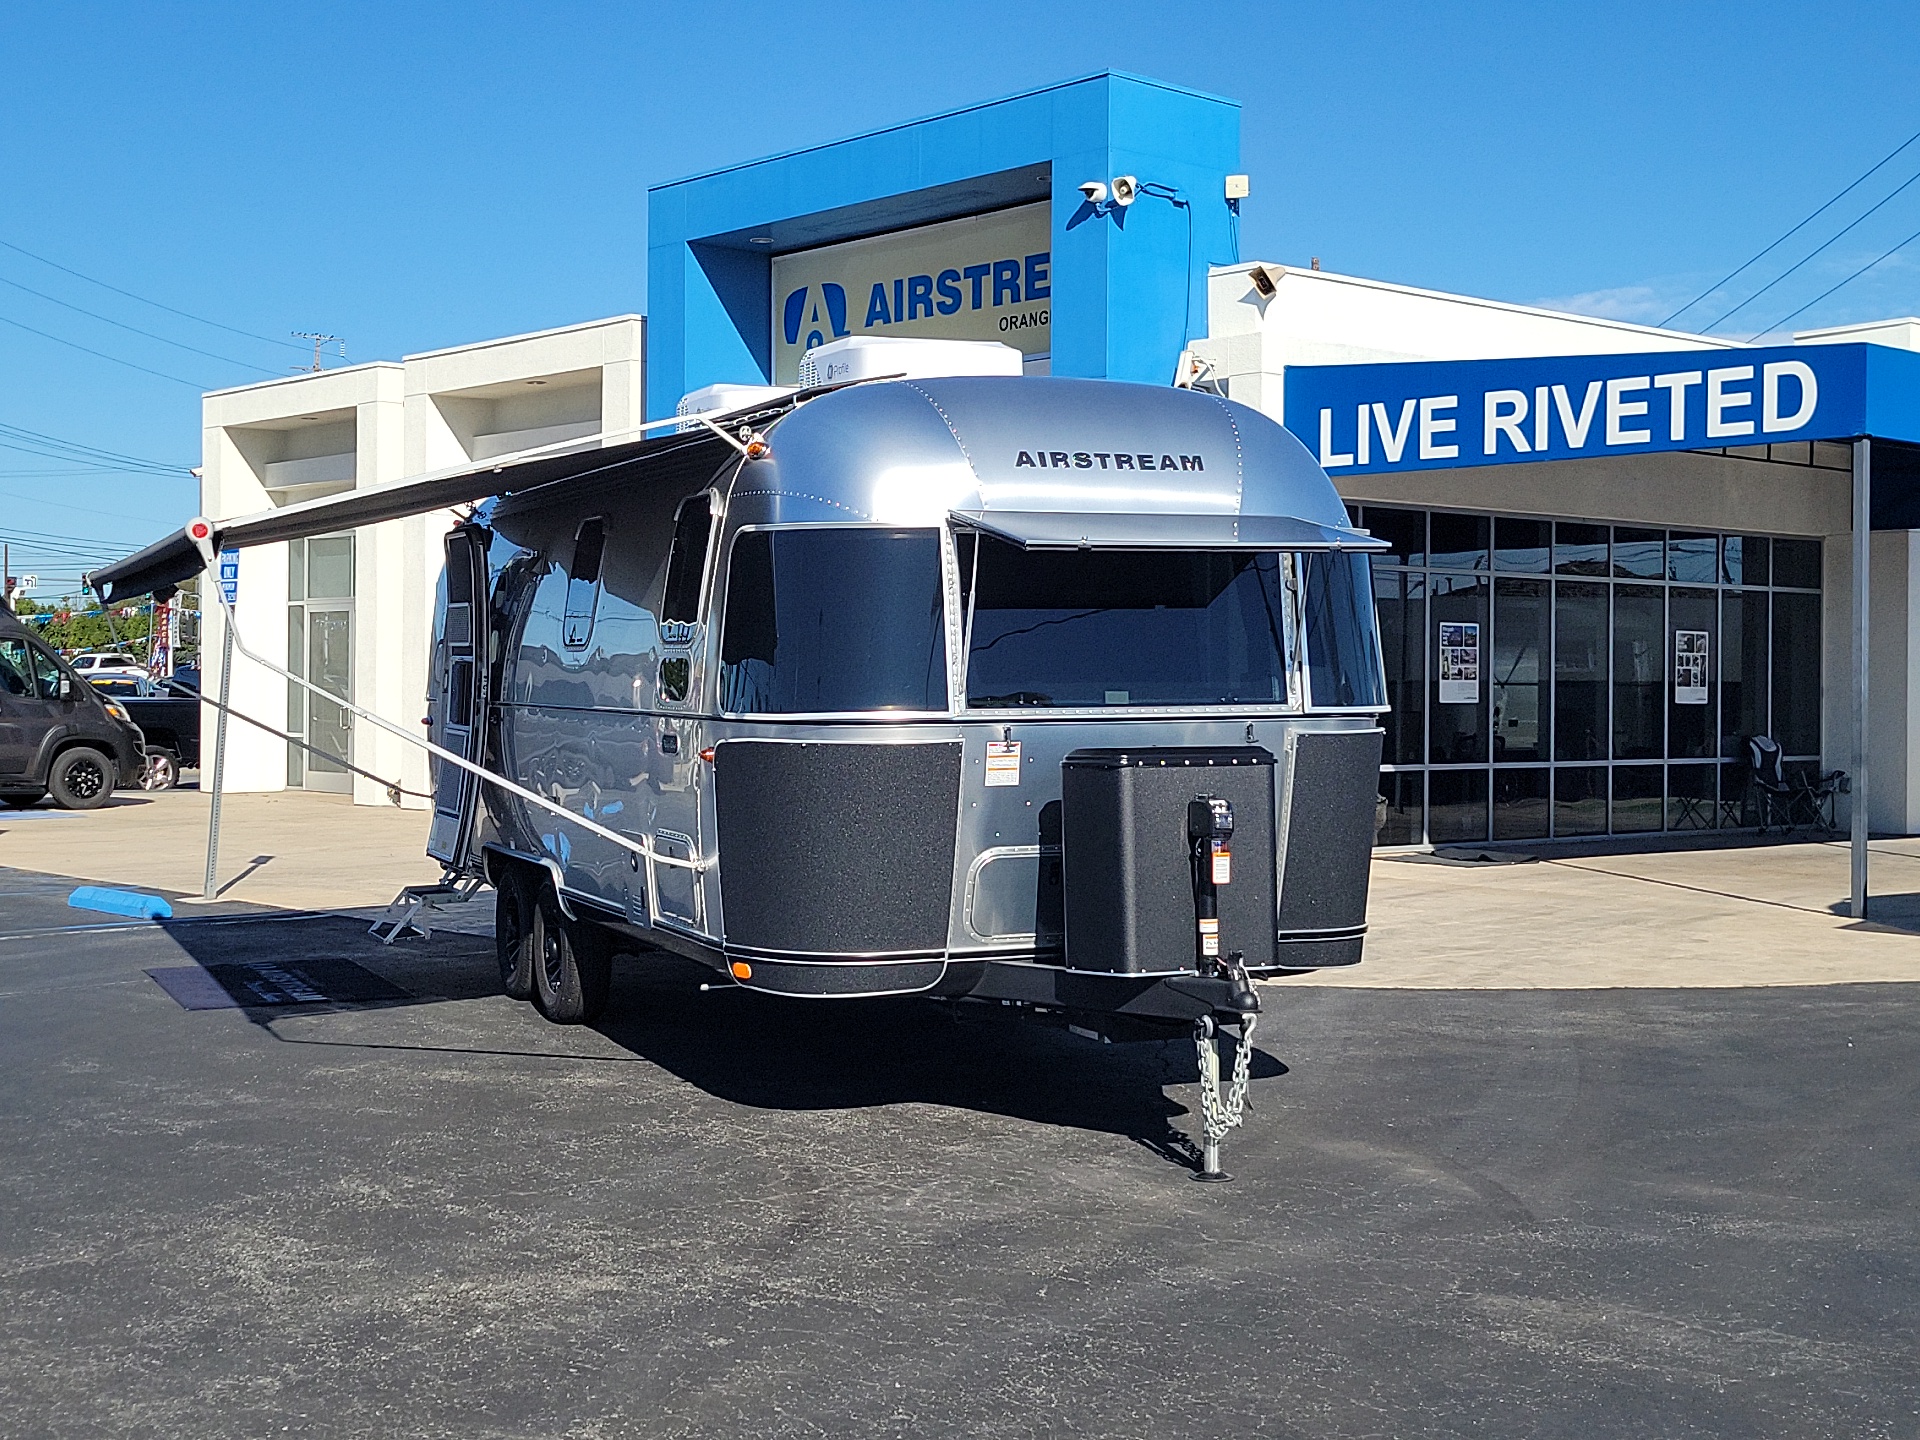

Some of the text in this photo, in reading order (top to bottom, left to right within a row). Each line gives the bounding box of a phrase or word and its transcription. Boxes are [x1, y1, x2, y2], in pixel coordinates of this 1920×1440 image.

[999, 310, 1050, 332] ORANG
[1318, 361, 1819, 468] LIVE RIVETED
[1015, 450, 1204, 472] AIRSTREAM
